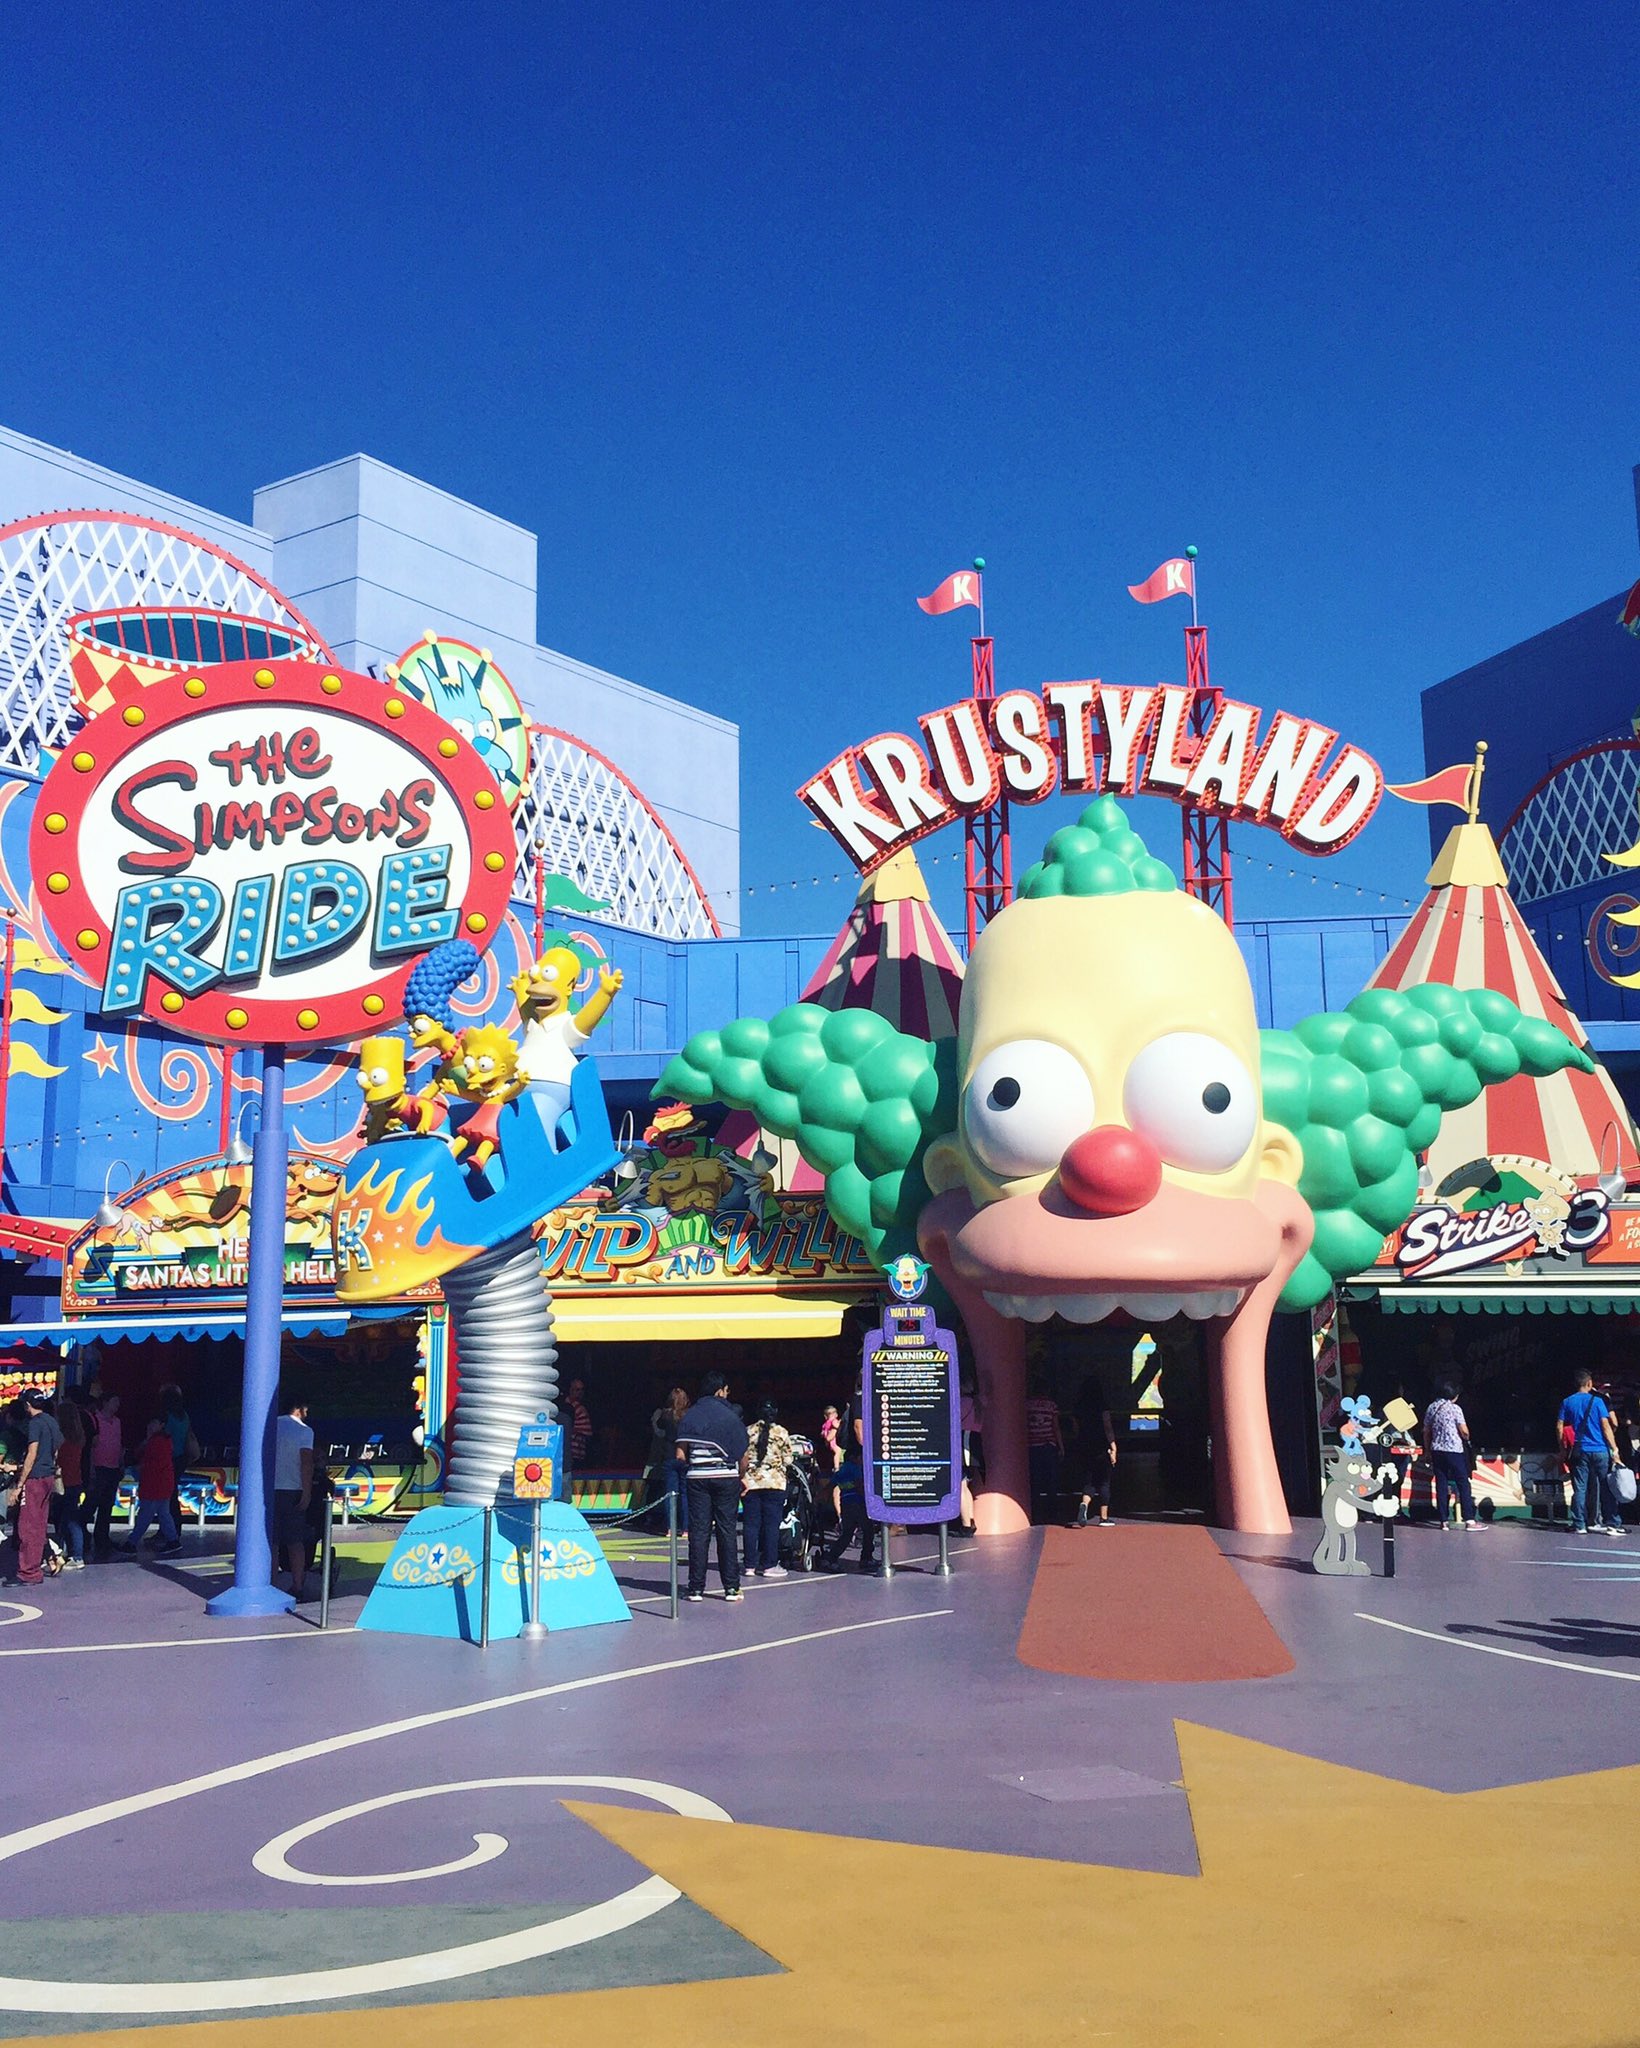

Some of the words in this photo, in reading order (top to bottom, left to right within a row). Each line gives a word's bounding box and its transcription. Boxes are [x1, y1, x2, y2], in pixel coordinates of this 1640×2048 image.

[953, 575, 973, 603] K
[1166, 562, 1186, 591] K
[798, 680, 1382, 872] KRUSTYLAND
[101, 843, 464, 1018] RIDE
[338, 1208, 374, 1271] K
[1399, 1202, 1533, 1263] Strike
[215, 1262, 250, 1286] LIT
[290, 1261, 336, 1282] HEL
[665, 1251, 715, 1280] AND
[890, 1307, 908, 1318] WAIT
[909, 1306, 926, 1317] TIME
[894, 1334, 926, 1346] MINUTES
[886, 1351, 935, 1361] WARNING
